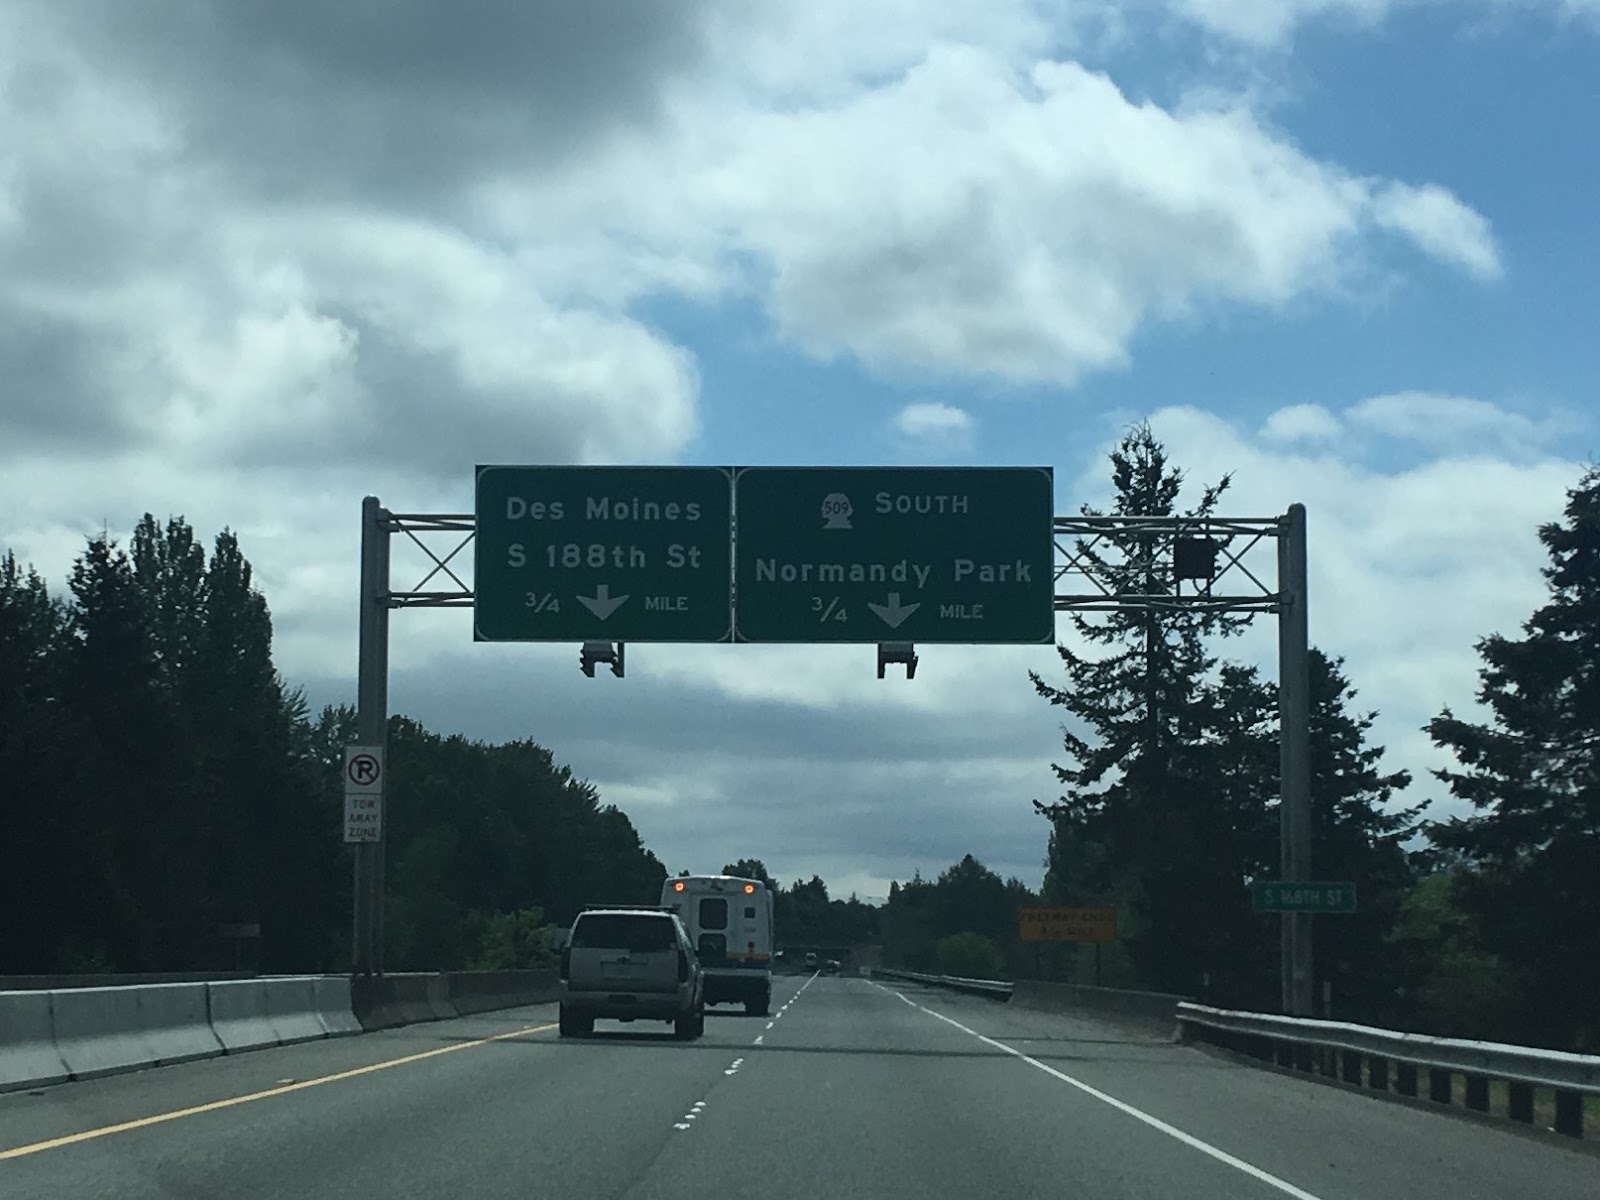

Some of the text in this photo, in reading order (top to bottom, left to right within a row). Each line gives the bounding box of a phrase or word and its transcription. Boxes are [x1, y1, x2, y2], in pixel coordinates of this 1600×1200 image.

[506, 497, 701, 521] Des Moines
[824, 491, 968, 514] 509 SOUTH
[507, 543, 702, 568] S 188th St
[755, 558, 1032, 588] Normandy Park
[524, 592, 689, 613] 3/4 MILE
[811, 596, 984, 622] 3/4 MILE
[351, 799, 375, 809] TOW
[348, 813, 379, 823] AWAY
[348, 826, 378, 838] ZONE
